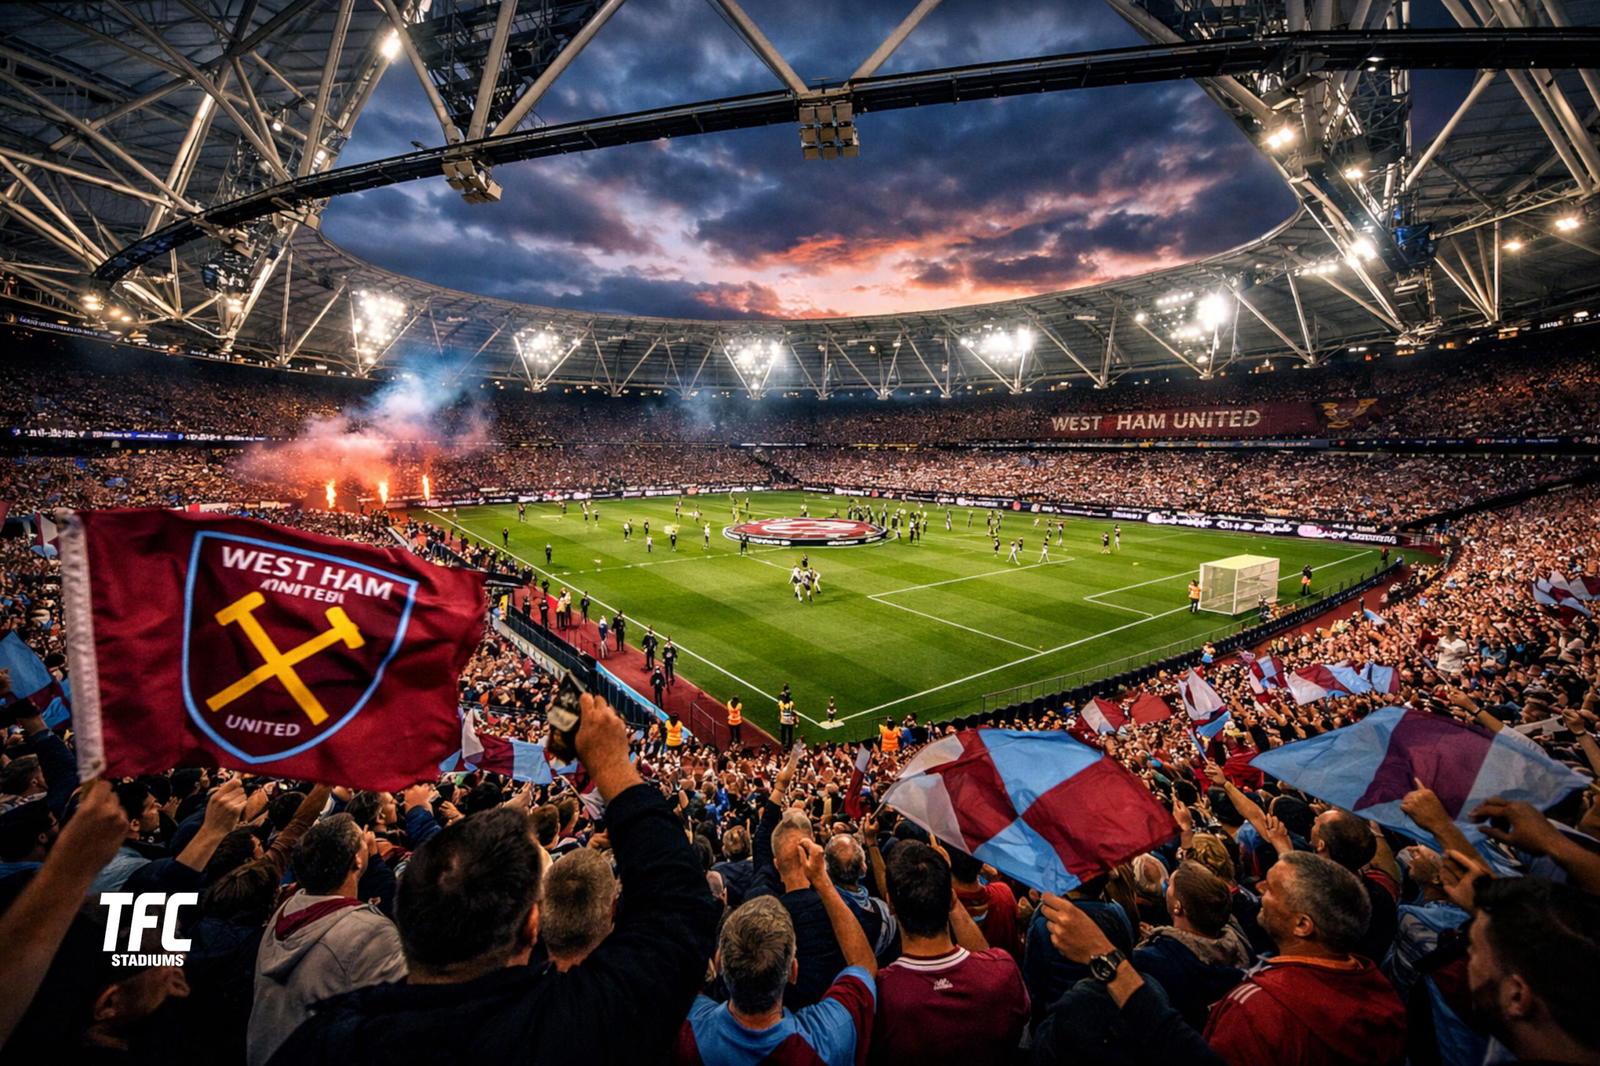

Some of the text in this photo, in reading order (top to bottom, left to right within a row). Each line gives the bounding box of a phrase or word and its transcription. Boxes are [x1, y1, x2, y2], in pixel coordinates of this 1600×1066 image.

[1051, 409, 1261, 431] WEST HAM UNITED
[221, 546, 394, 600] WEST HAM
[225, 714, 300, 737] UNITED
